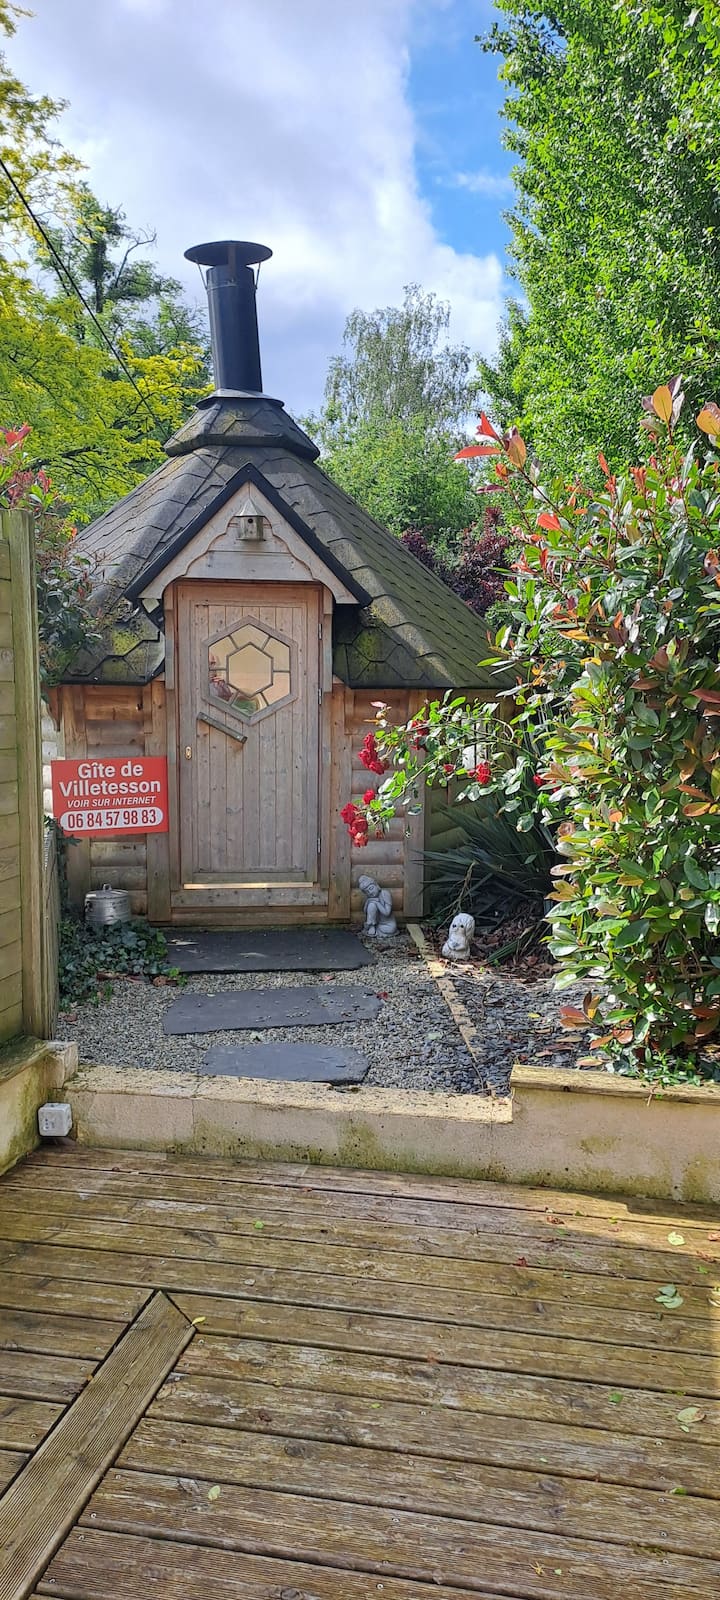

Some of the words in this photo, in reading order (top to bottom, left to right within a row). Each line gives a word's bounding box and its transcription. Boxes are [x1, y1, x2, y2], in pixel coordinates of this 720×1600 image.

[78, 762, 116, 779] Gîte
[121, 761, 143, 777] de
[59, 780, 161, 797] Villetesson
[67, 799, 89, 808] VOIR
[92, 798, 110, 807] SUR
[112, 796, 156, 806] INTERNET
[68, 813, 83, 828] 06
[87, 812, 102, 827] 84
[106, 811, 120, 826] 57
[123, 810, 138, 825] 98
[142, 809, 156, 824] 83
